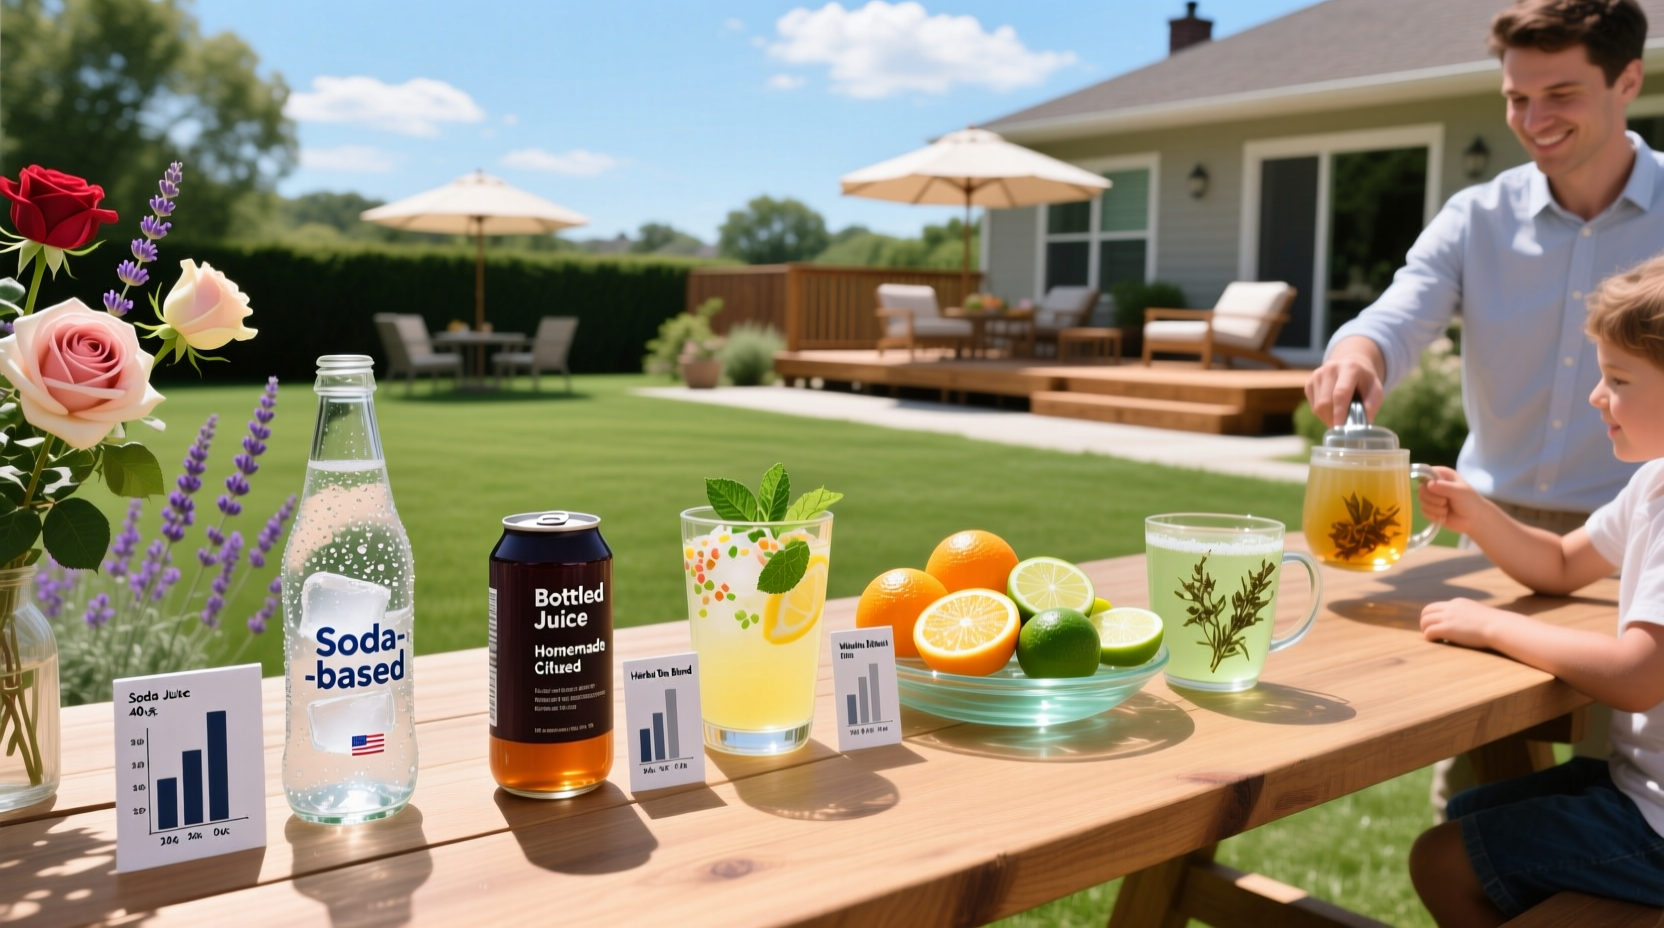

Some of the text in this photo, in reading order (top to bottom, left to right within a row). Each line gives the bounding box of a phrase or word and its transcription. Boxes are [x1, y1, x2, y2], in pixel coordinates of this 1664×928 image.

[535, 582, 604, 607] Bottled
[534, 609, 588, 630] Juice
[316, 622, 405, 657] Soda-
[305, 648, 404, 690] -based
[128, 690, 159, 704] Soda
